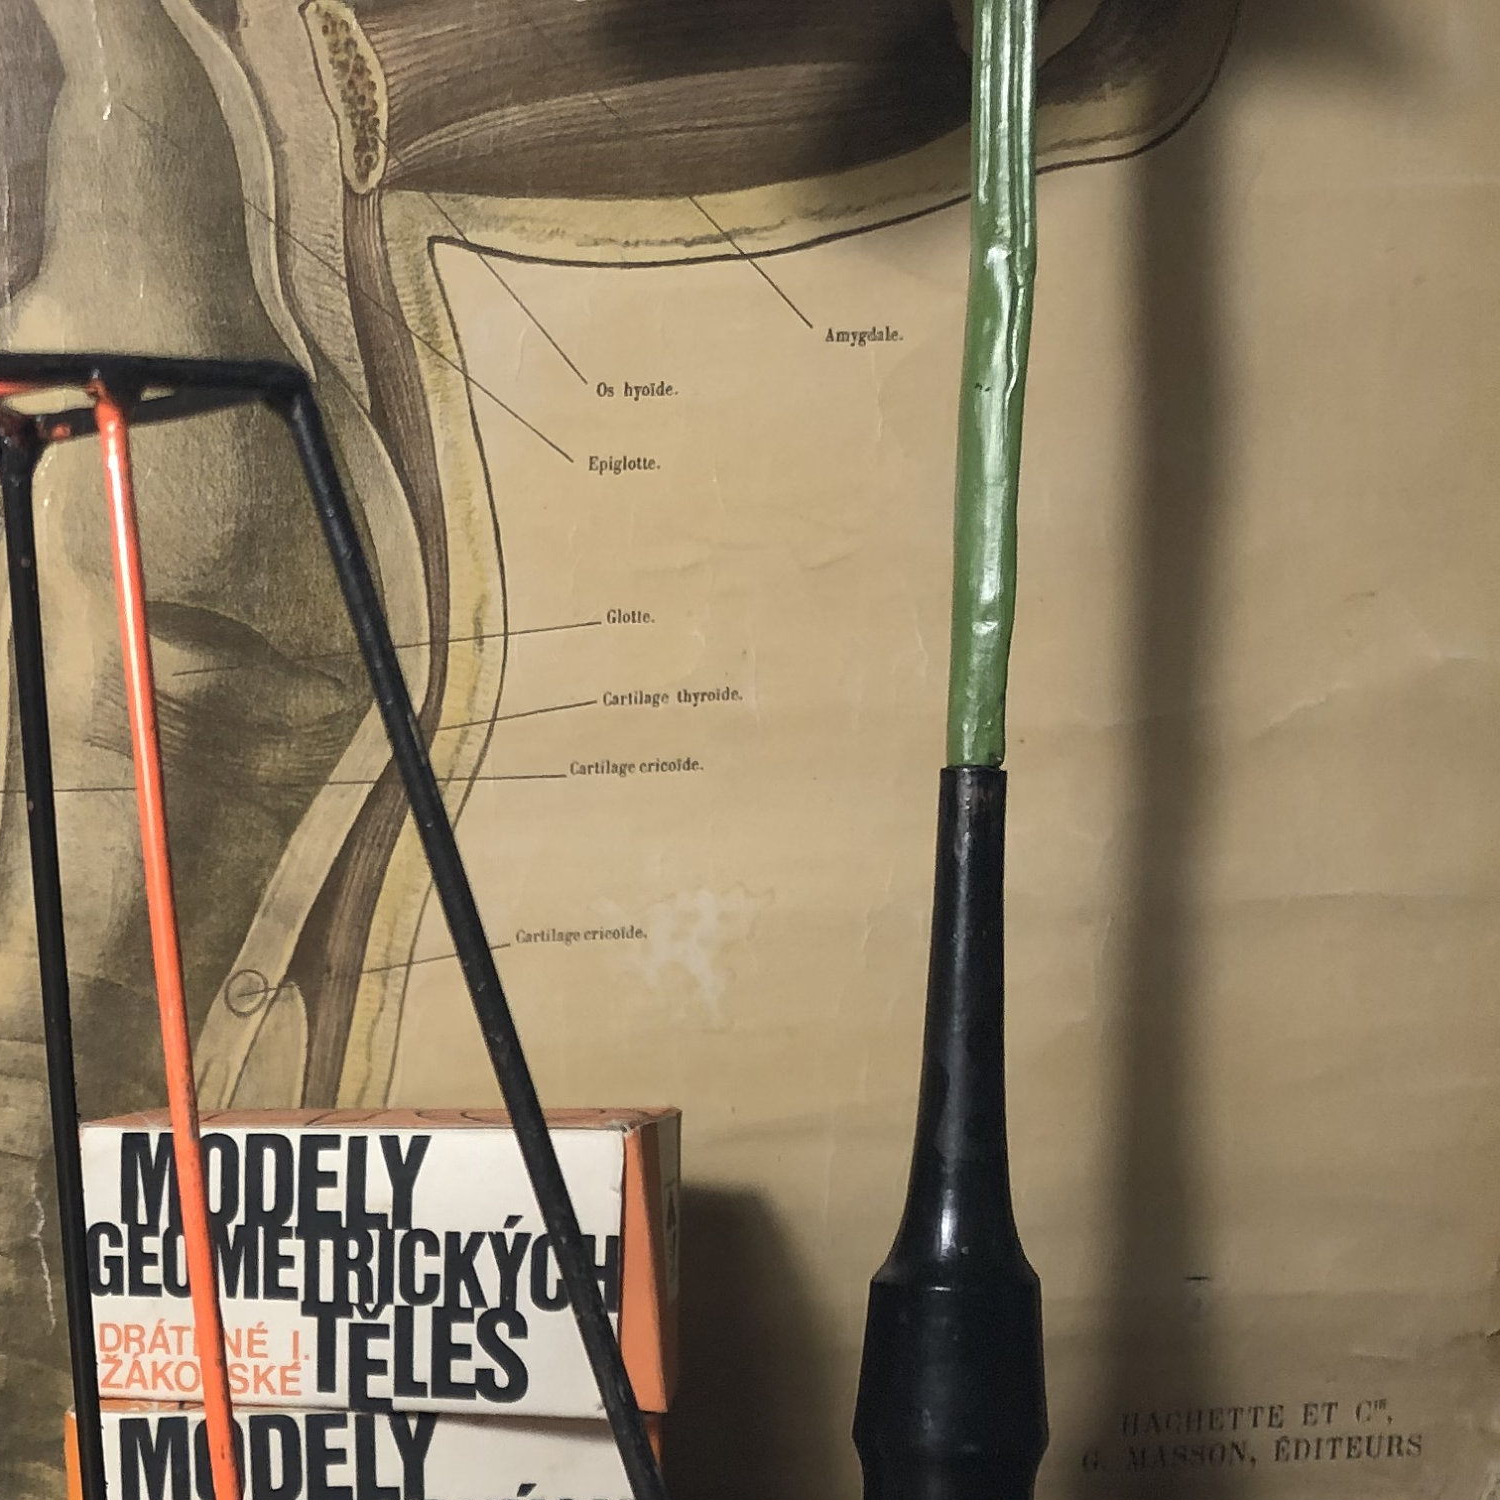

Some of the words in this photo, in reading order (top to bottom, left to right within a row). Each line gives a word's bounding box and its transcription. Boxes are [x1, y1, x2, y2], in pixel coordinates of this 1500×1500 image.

[825, 326, 904, 347] Amygdale.
[596, 382, 615, 398] Os
[588, 455, 661, 475] Epiglotte.
[606, 609, 656, 625] Glotte.
[602, 690, 669, 708] Cartilage
[569, 760, 636, 778] Cartilage
[515, 928, 581, 946] Cartilage
[121, 1132, 431, 1228] MODELY
[86, 1215, 620, 1313] GEOMETRICKÝCH
[100, 1318, 268, 1360] DRÁTNÉ
[301, 1302, 528, 1413] TĚLES
[100, 1352, 302, 1396] ŽÁKOSKÉ
[1121, 1404, 1285, 1436] HACHETTE
[1302, 1402, 1338, 1427] ET
